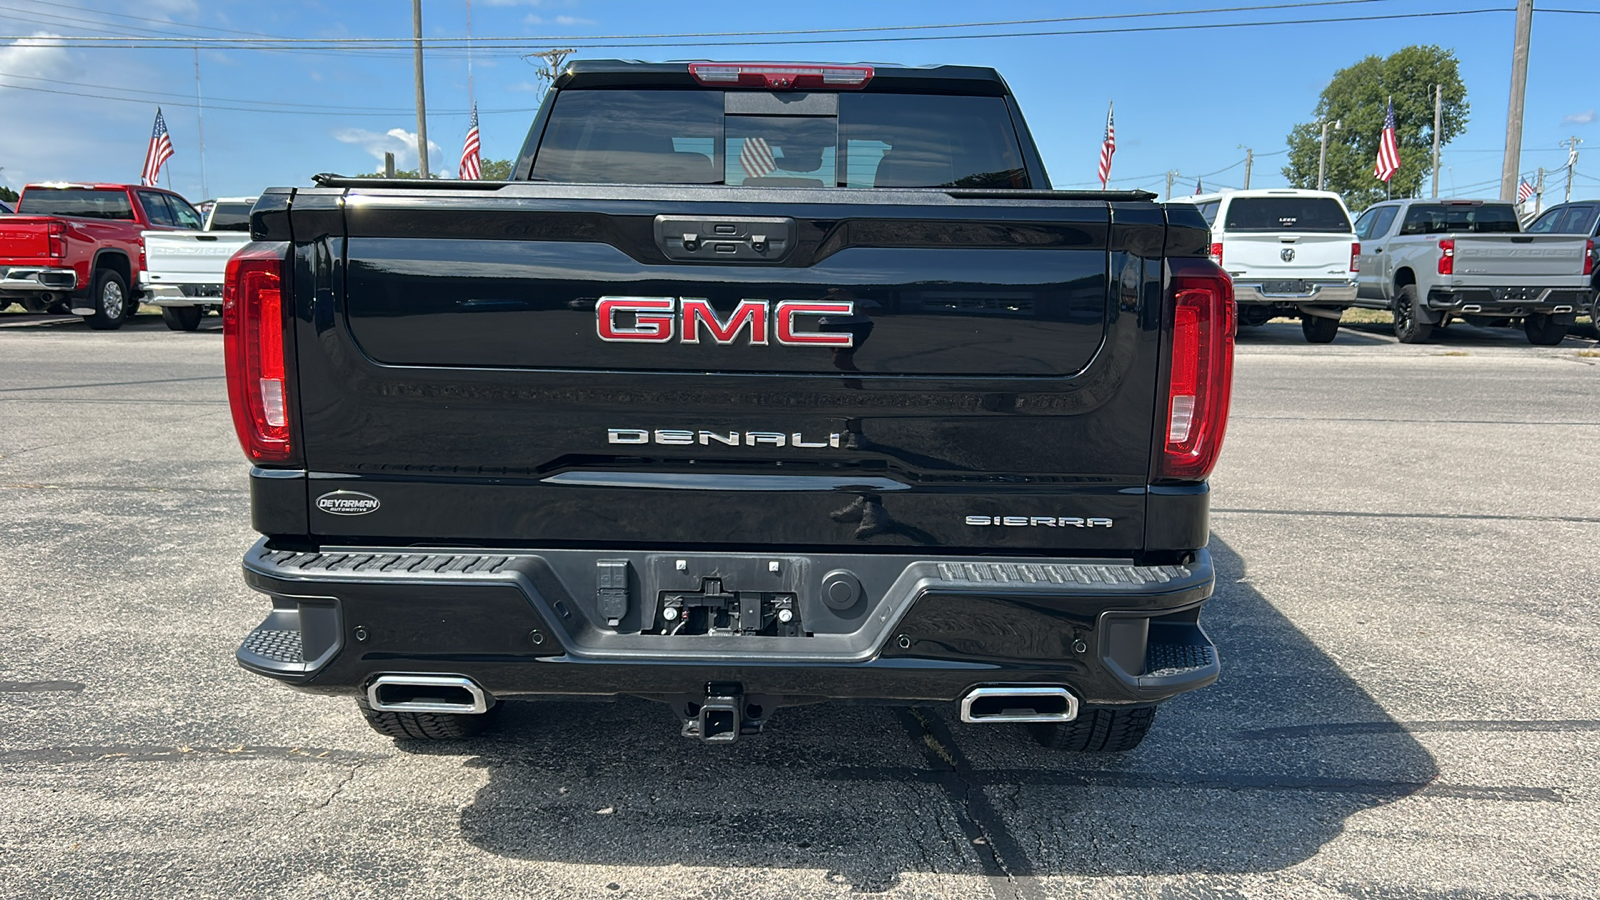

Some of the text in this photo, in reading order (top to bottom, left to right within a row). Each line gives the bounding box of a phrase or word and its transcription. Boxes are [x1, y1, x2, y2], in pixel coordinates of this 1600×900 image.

[595, 296, 854, 347] GMC
[607, 428, 840, 448] DENALI
[320, 499, 377, 508] DEYARMAN
[965, 515, 1113, 528] SIERRA
